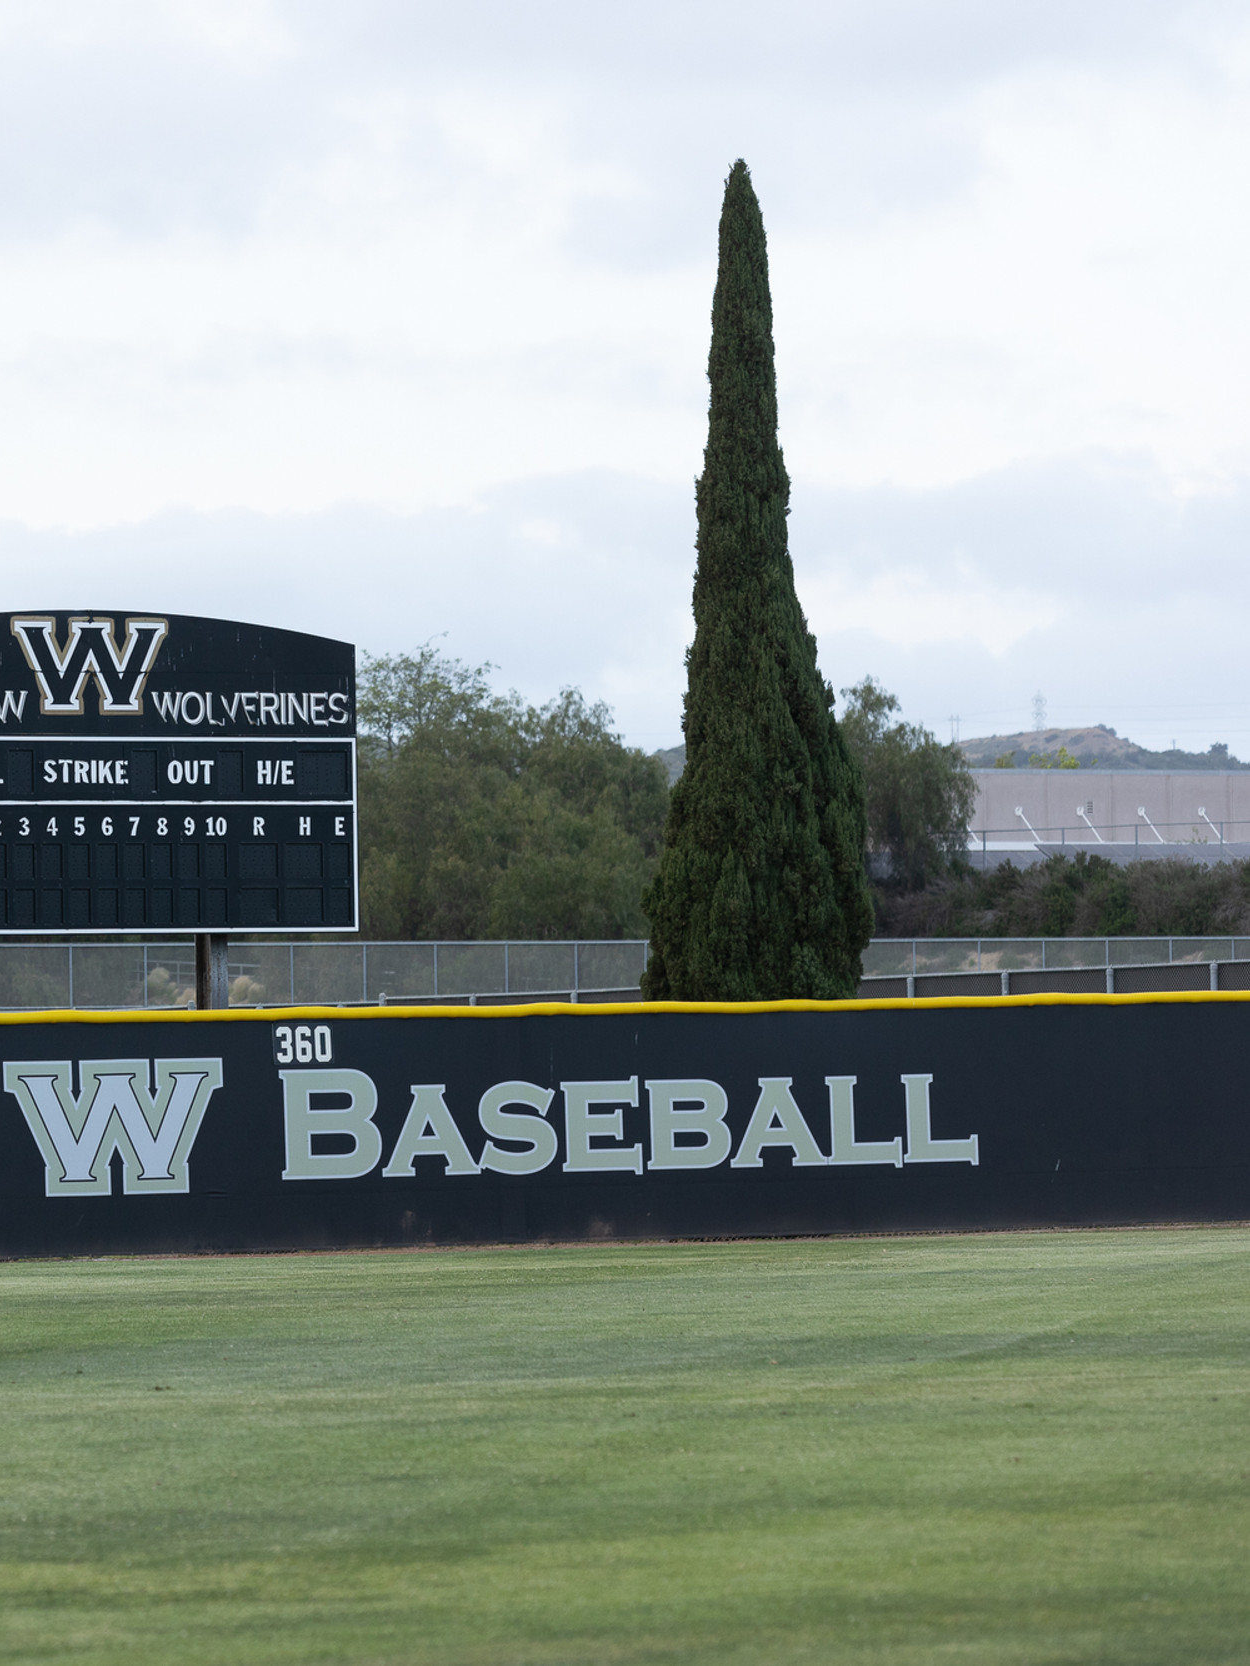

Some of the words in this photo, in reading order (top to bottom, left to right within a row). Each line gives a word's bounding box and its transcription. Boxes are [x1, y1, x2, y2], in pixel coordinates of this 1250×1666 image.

[10, 616, 168, 715] W
[151, 691, 349, 727] WOLVERINES
[43, 758, 129, 785] STRIKE
[167, 759, 215, 785] OUT
[257, 759, 295, 786] H/E
[18, 816, 31, 837] 3
[46, 816, 59, 837] 4
[73, 816, 86, 837] 5
[101, 816, 114, 837] 6
[128, 816, 141, 837] 7
[156, 817, 169, 837] 8
[183, 816, 196, 837] 9
[205, 816, 228, 837] 10
[253, 816, 265, 837] R
[299, 816, 311, 837] H
[334, 816, 346, 837] E
[275, 1025, 333, 1064] 360
[1, 1057, 225, 1199] W
[278, 1068, 980, 1181] BASEBALL
